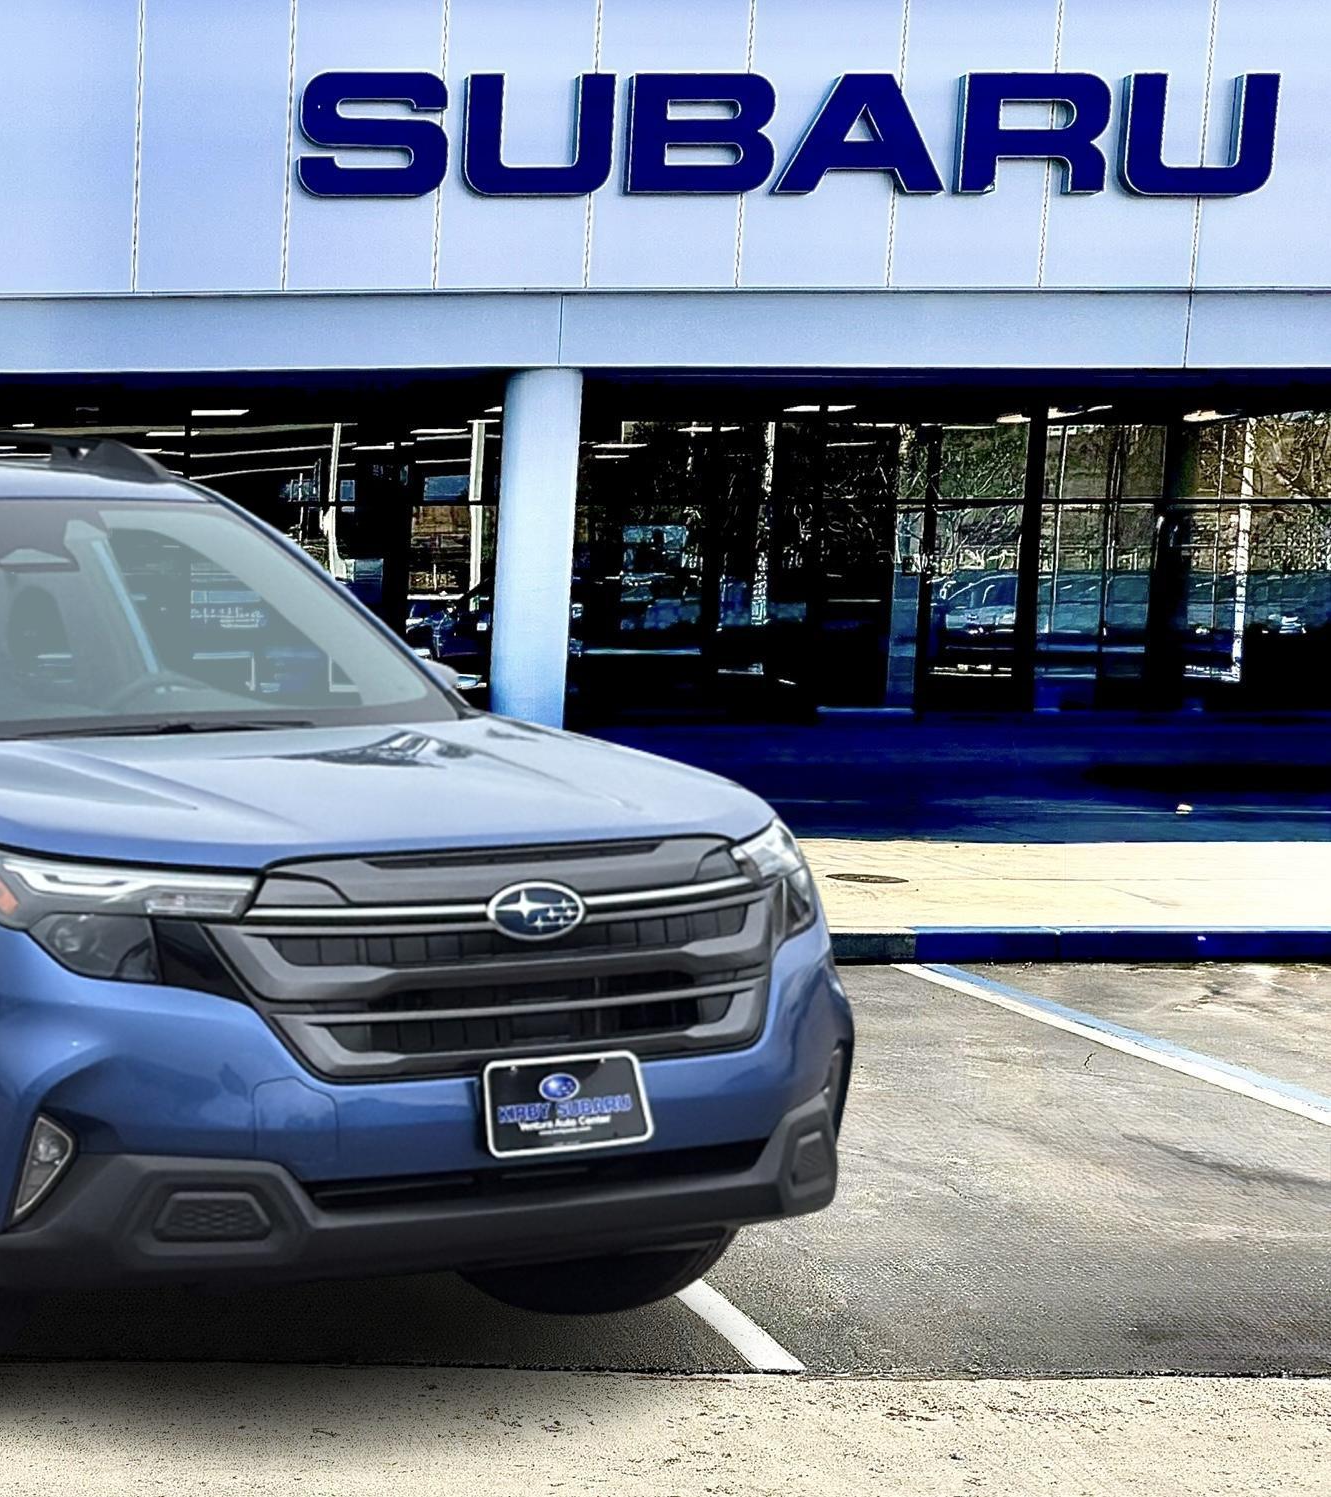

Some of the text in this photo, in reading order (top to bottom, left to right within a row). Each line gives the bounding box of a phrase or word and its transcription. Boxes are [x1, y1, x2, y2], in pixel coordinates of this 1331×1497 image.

[297, 72, 1282, 197] SUBARU
[498, 1094, 633, 1123] KIRBY SUBARU
